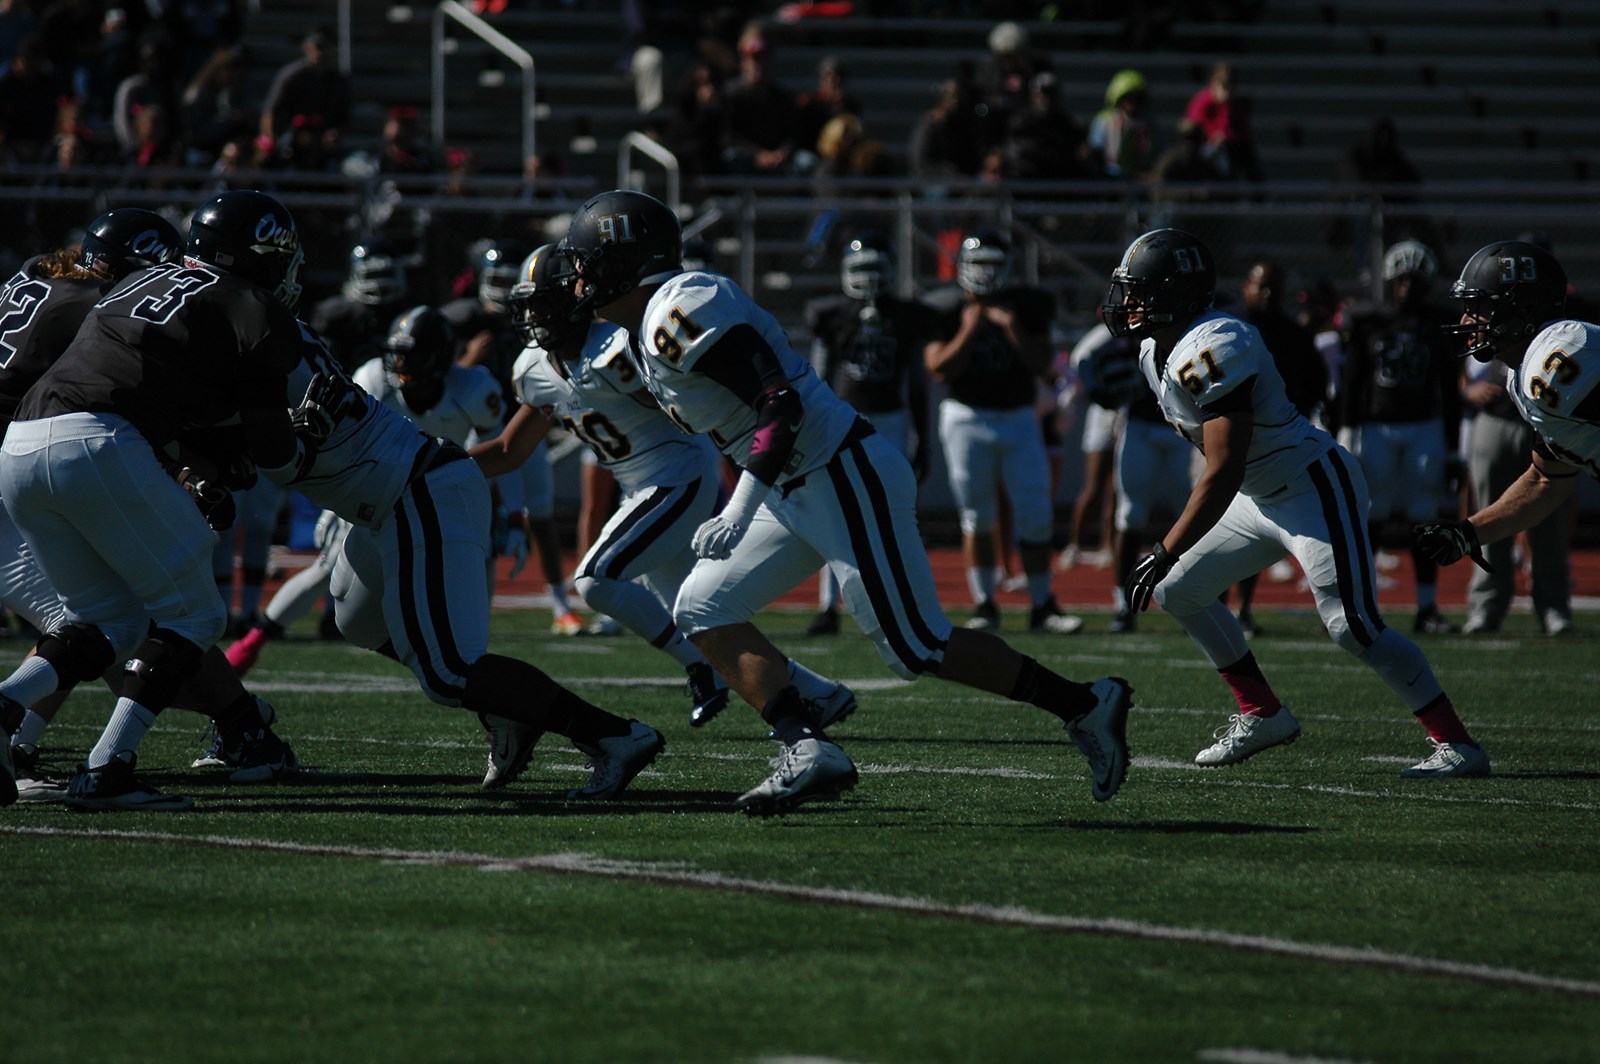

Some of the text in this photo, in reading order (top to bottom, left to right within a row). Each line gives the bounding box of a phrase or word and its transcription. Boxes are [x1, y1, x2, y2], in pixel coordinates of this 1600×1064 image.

[598, 212, 637, 246] 91
[1174, 247, 1206, 274] 51
[1499, 255, 1538, 283] 33
[94, 262, 220, 325] 73
[654, 305, 705, 364] 91
[1176, 348, 1224, 396] 51
[1530, 349, 1581, 409] 33
